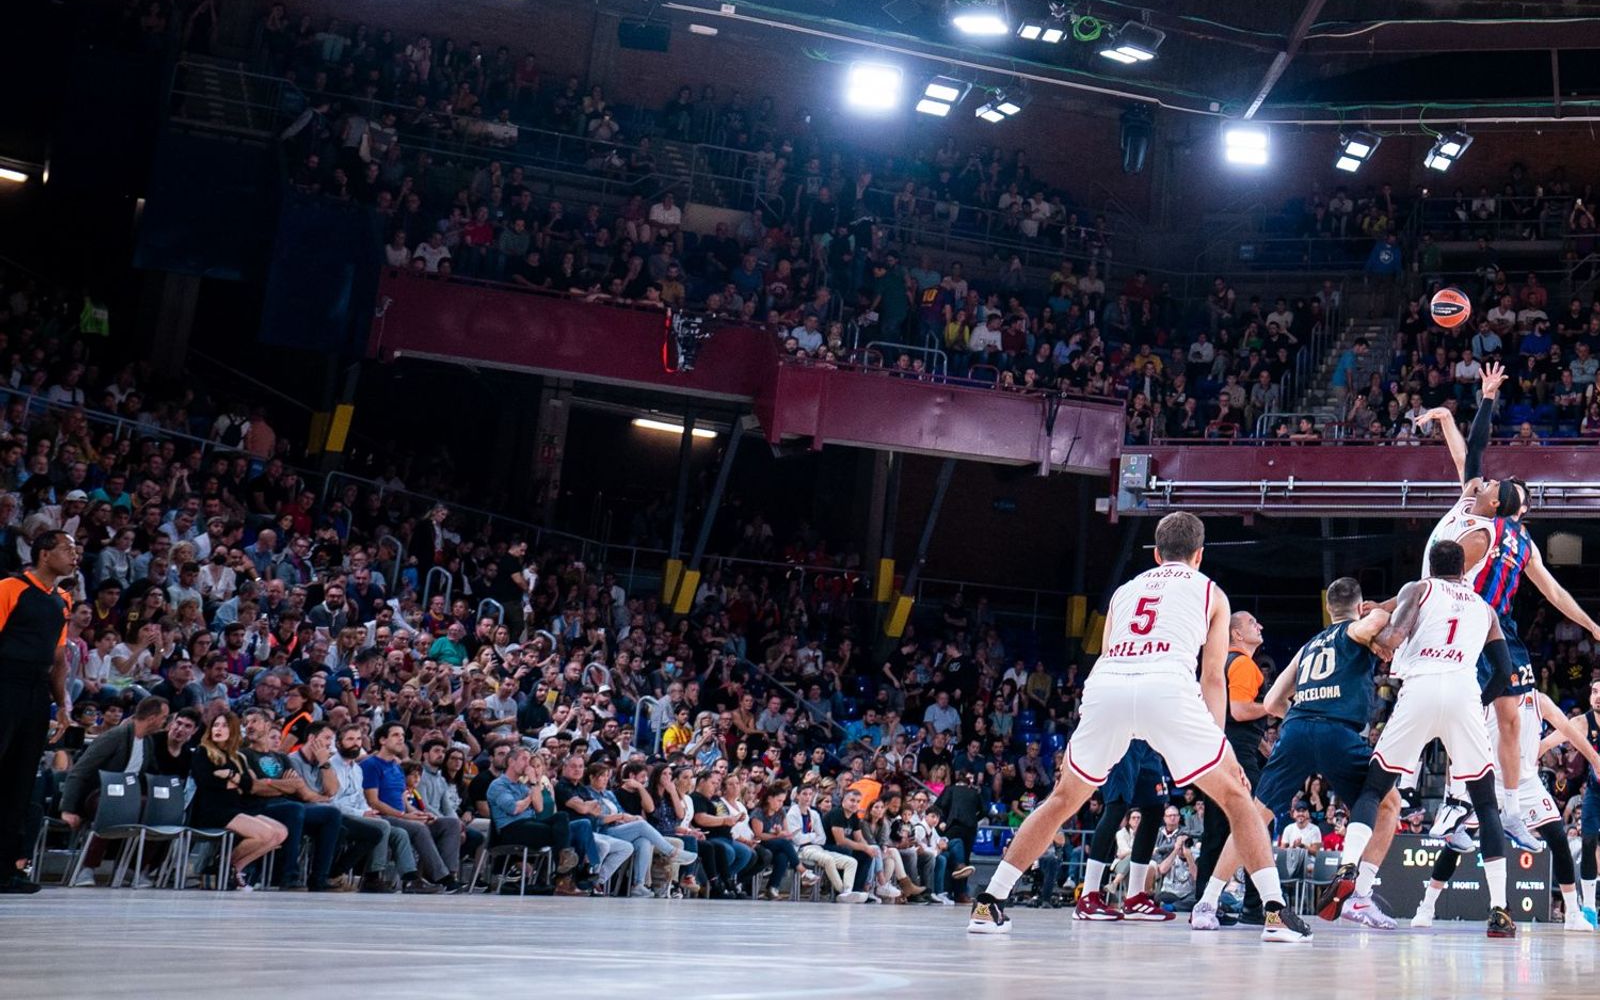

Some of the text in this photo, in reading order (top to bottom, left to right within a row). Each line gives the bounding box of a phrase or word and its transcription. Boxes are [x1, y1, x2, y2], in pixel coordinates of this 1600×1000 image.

[1130, 596, 1161, 636] 5
[1446, 618, 1459, 645] 1
[1298, 647, 1336, 686] 10
[1518, 664, 1535, 686] 23
[1293, 685, 1341, 702] ARCELONA
[1542, 798, 1553, 812] 9
[1519, 852, 1534, 869] 0
[1522, 897, 1533, 912] 0
